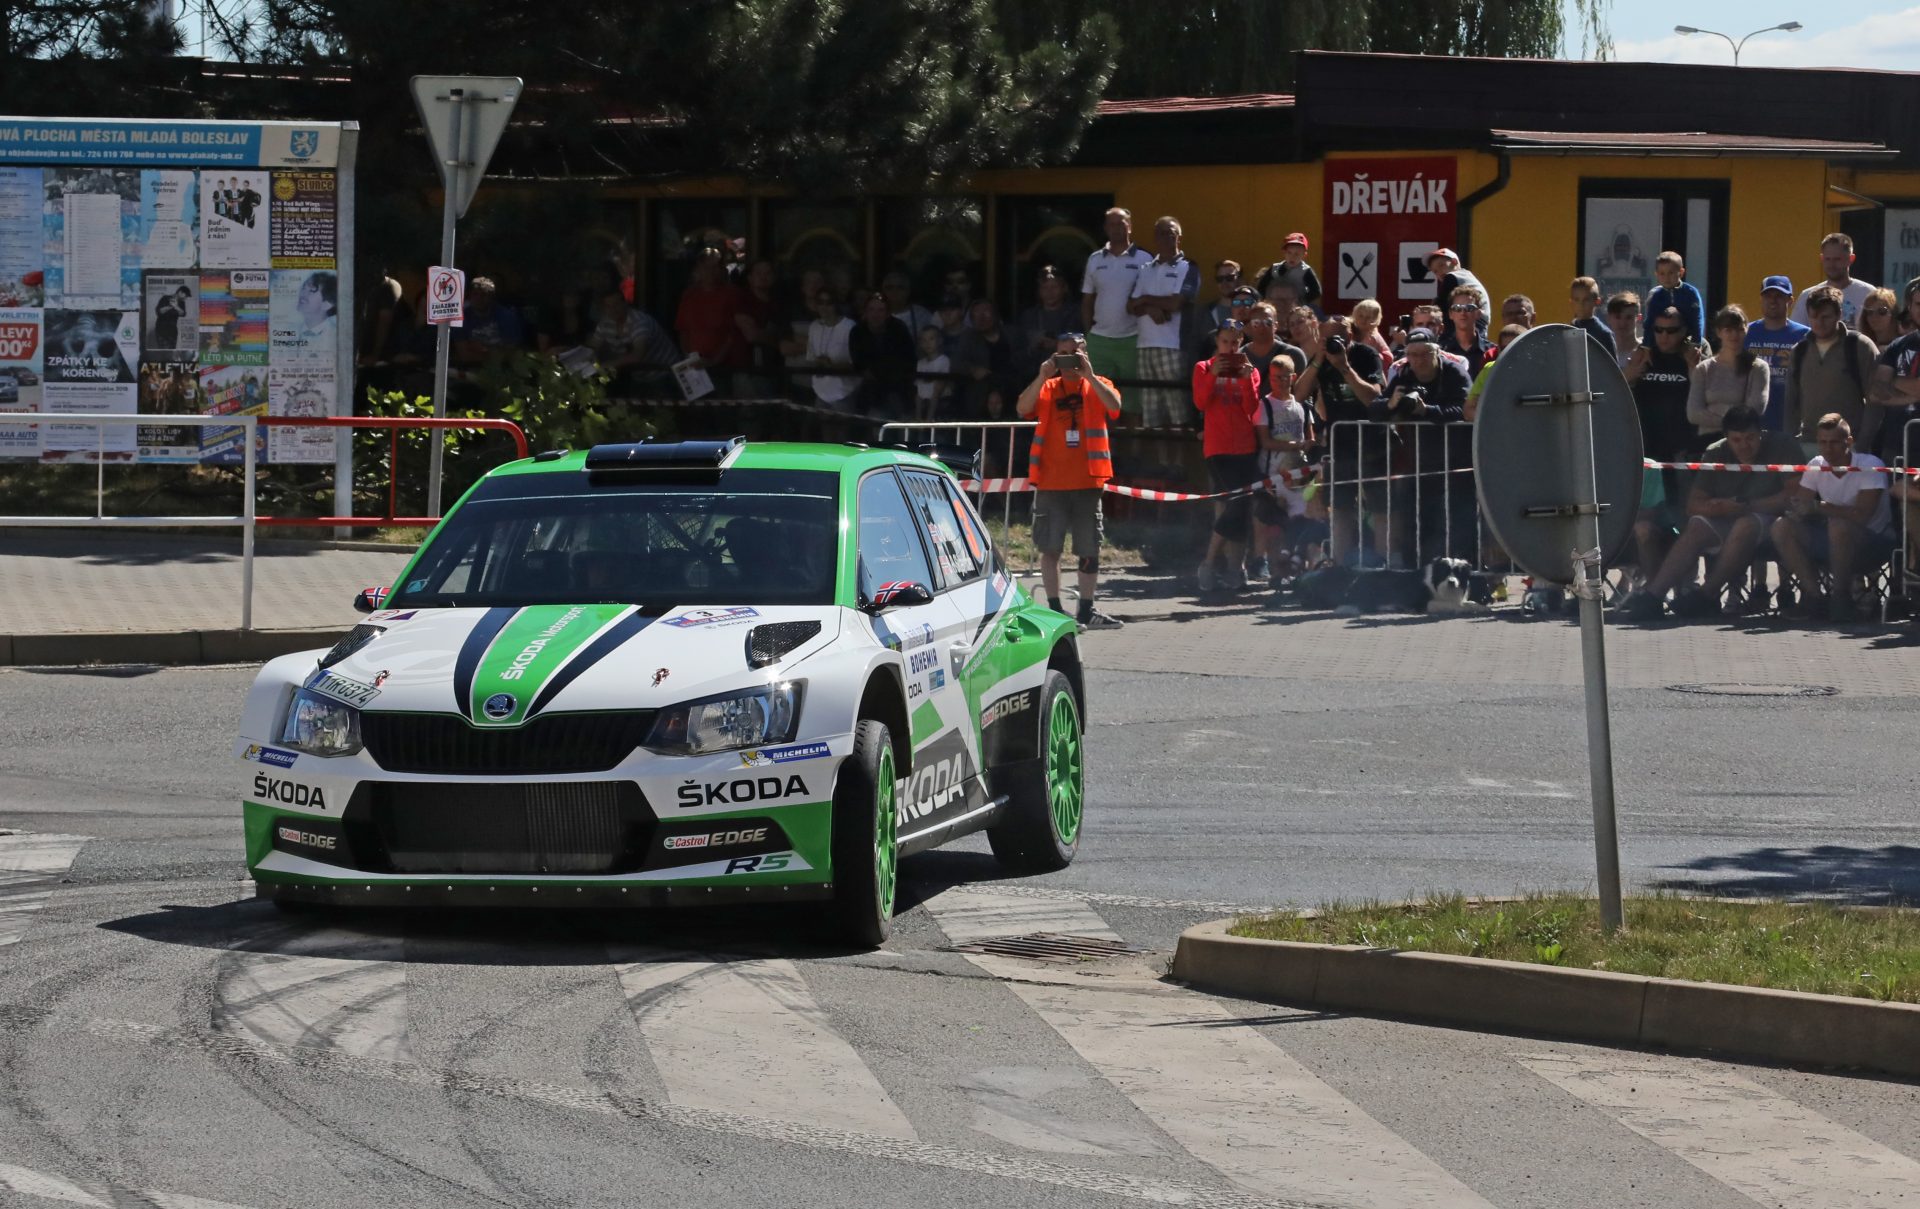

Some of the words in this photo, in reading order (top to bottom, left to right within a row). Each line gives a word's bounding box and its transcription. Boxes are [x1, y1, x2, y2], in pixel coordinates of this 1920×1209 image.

[24, 128, 77, 142] PLOCHA
[81, 128, 127, 143] MĚSTA
[131, 129, 178, 144] MLADÁ
[182, 131, 249, 145] BOLESLAV
[1332, 172, 1448, 215] DŘEVÁK
[48, 355, 90, 366] ZPÁTKY
[93, 358, 108, 366] KE
[499, 638, 551, 680] ŠKODA
[537, 606, 587, 637] Motorsport
[910, 647, 938, 674] BOHEMIA
[994, 691, 1032, 720] EDGE
[264, 752, 296, 763] MICHELIN
[773, 746, 828, 759] MICHELIN
[254, 771, 326, 810] ŠKODA
[677, 775, 810, 808] ŠKODA
[301, 832, 337, 850] EDGE
[674, 835, 707, 848] Castrol
[709, 827, 769, 847] EDGE
[724, 853, 793, 875] R5
